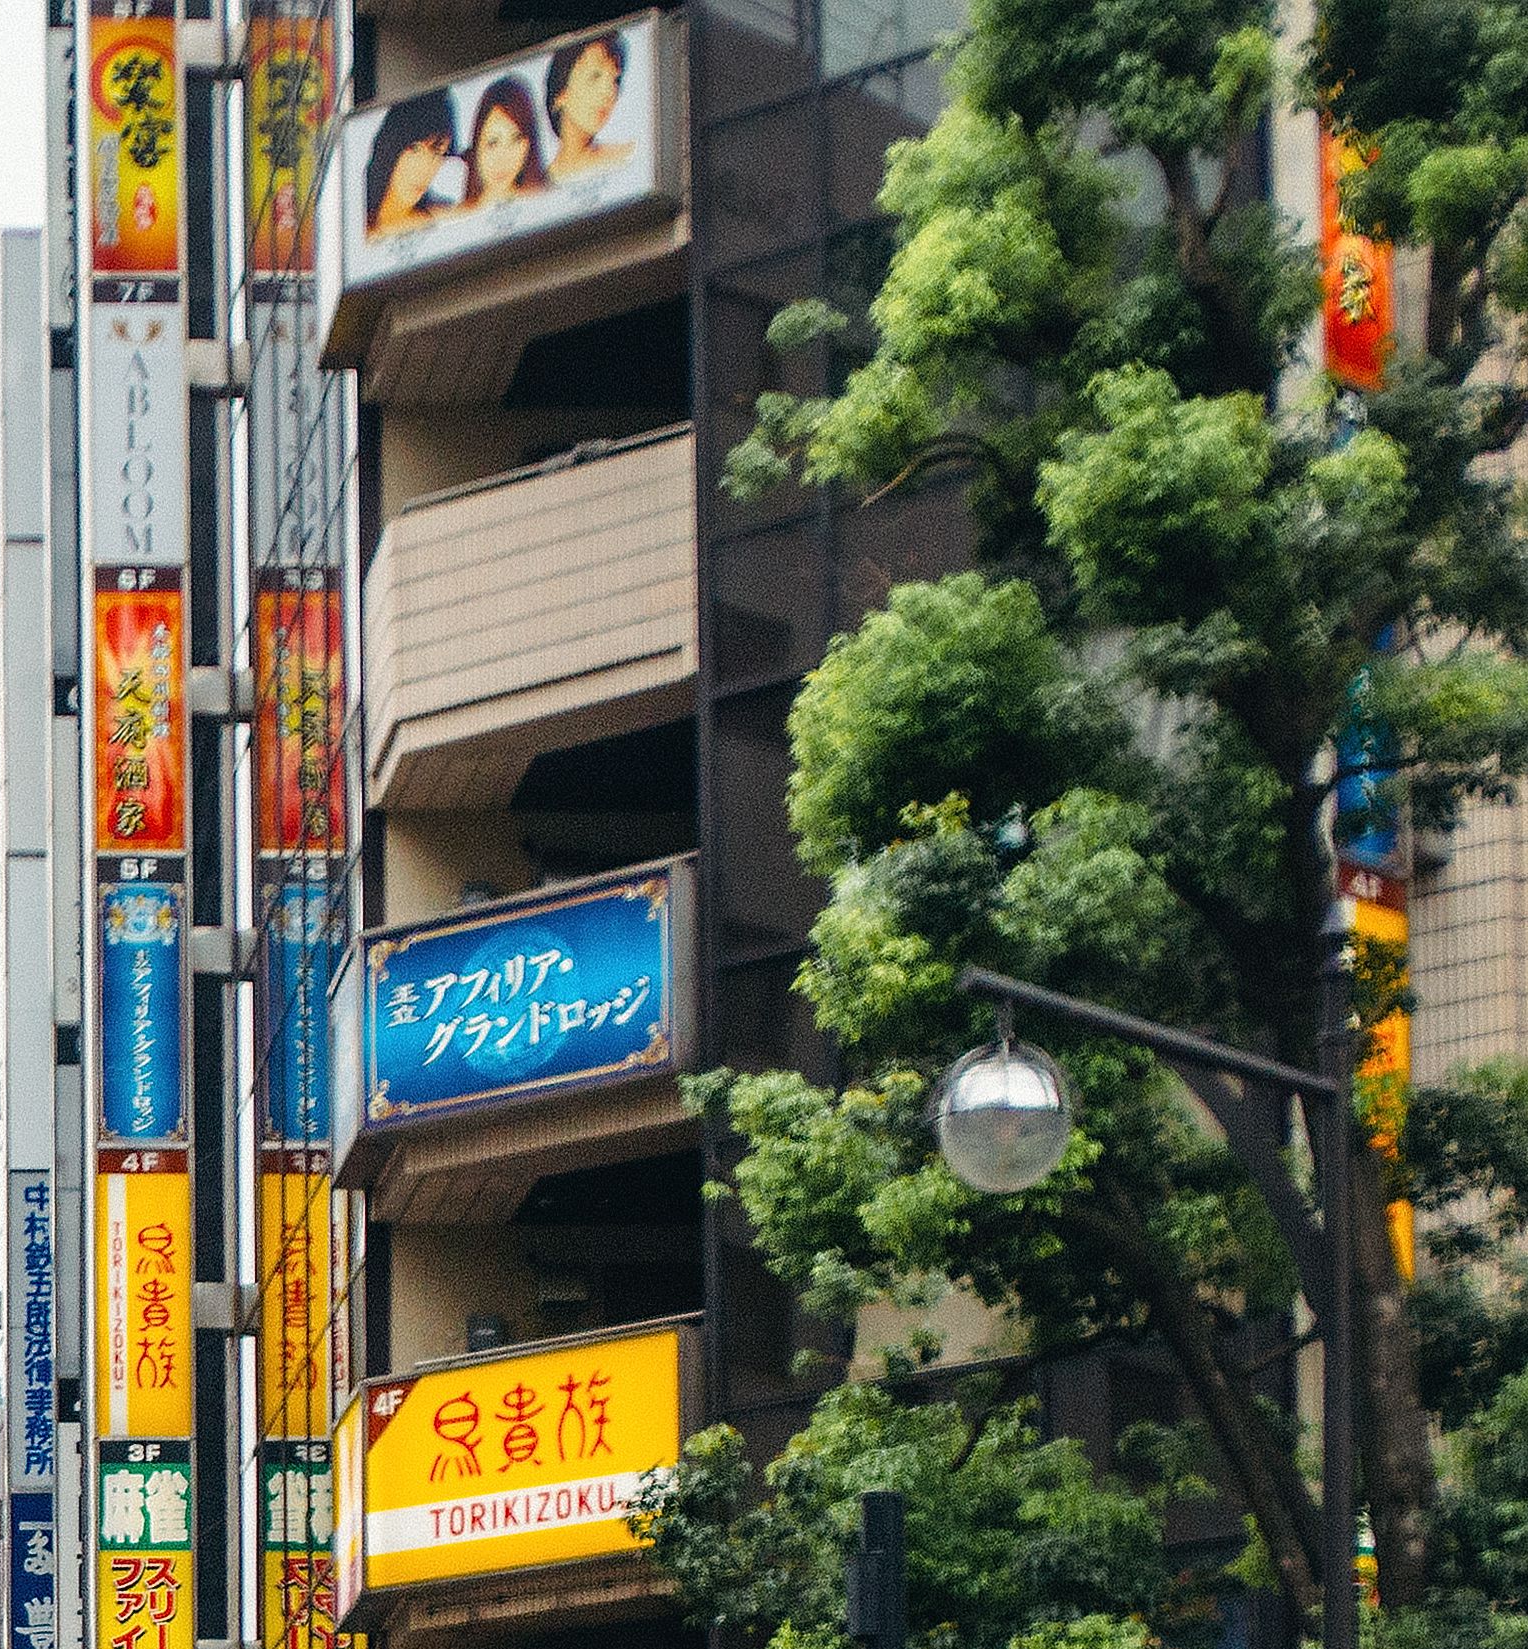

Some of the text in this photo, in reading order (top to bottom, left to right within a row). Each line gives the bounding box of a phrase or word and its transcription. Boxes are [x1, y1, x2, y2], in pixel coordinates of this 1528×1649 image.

[422, 975, 652, 1067] グランドロッジ
[120, 1153, 160, 1174] 4F
[371, 1390, 404, 1416] 4F
[127, 1444, 162, 1463] 3F
[100, 1470, 190, 1545] 麻雀
[429, 1483, 618, 1540] TORIKIZOKU
